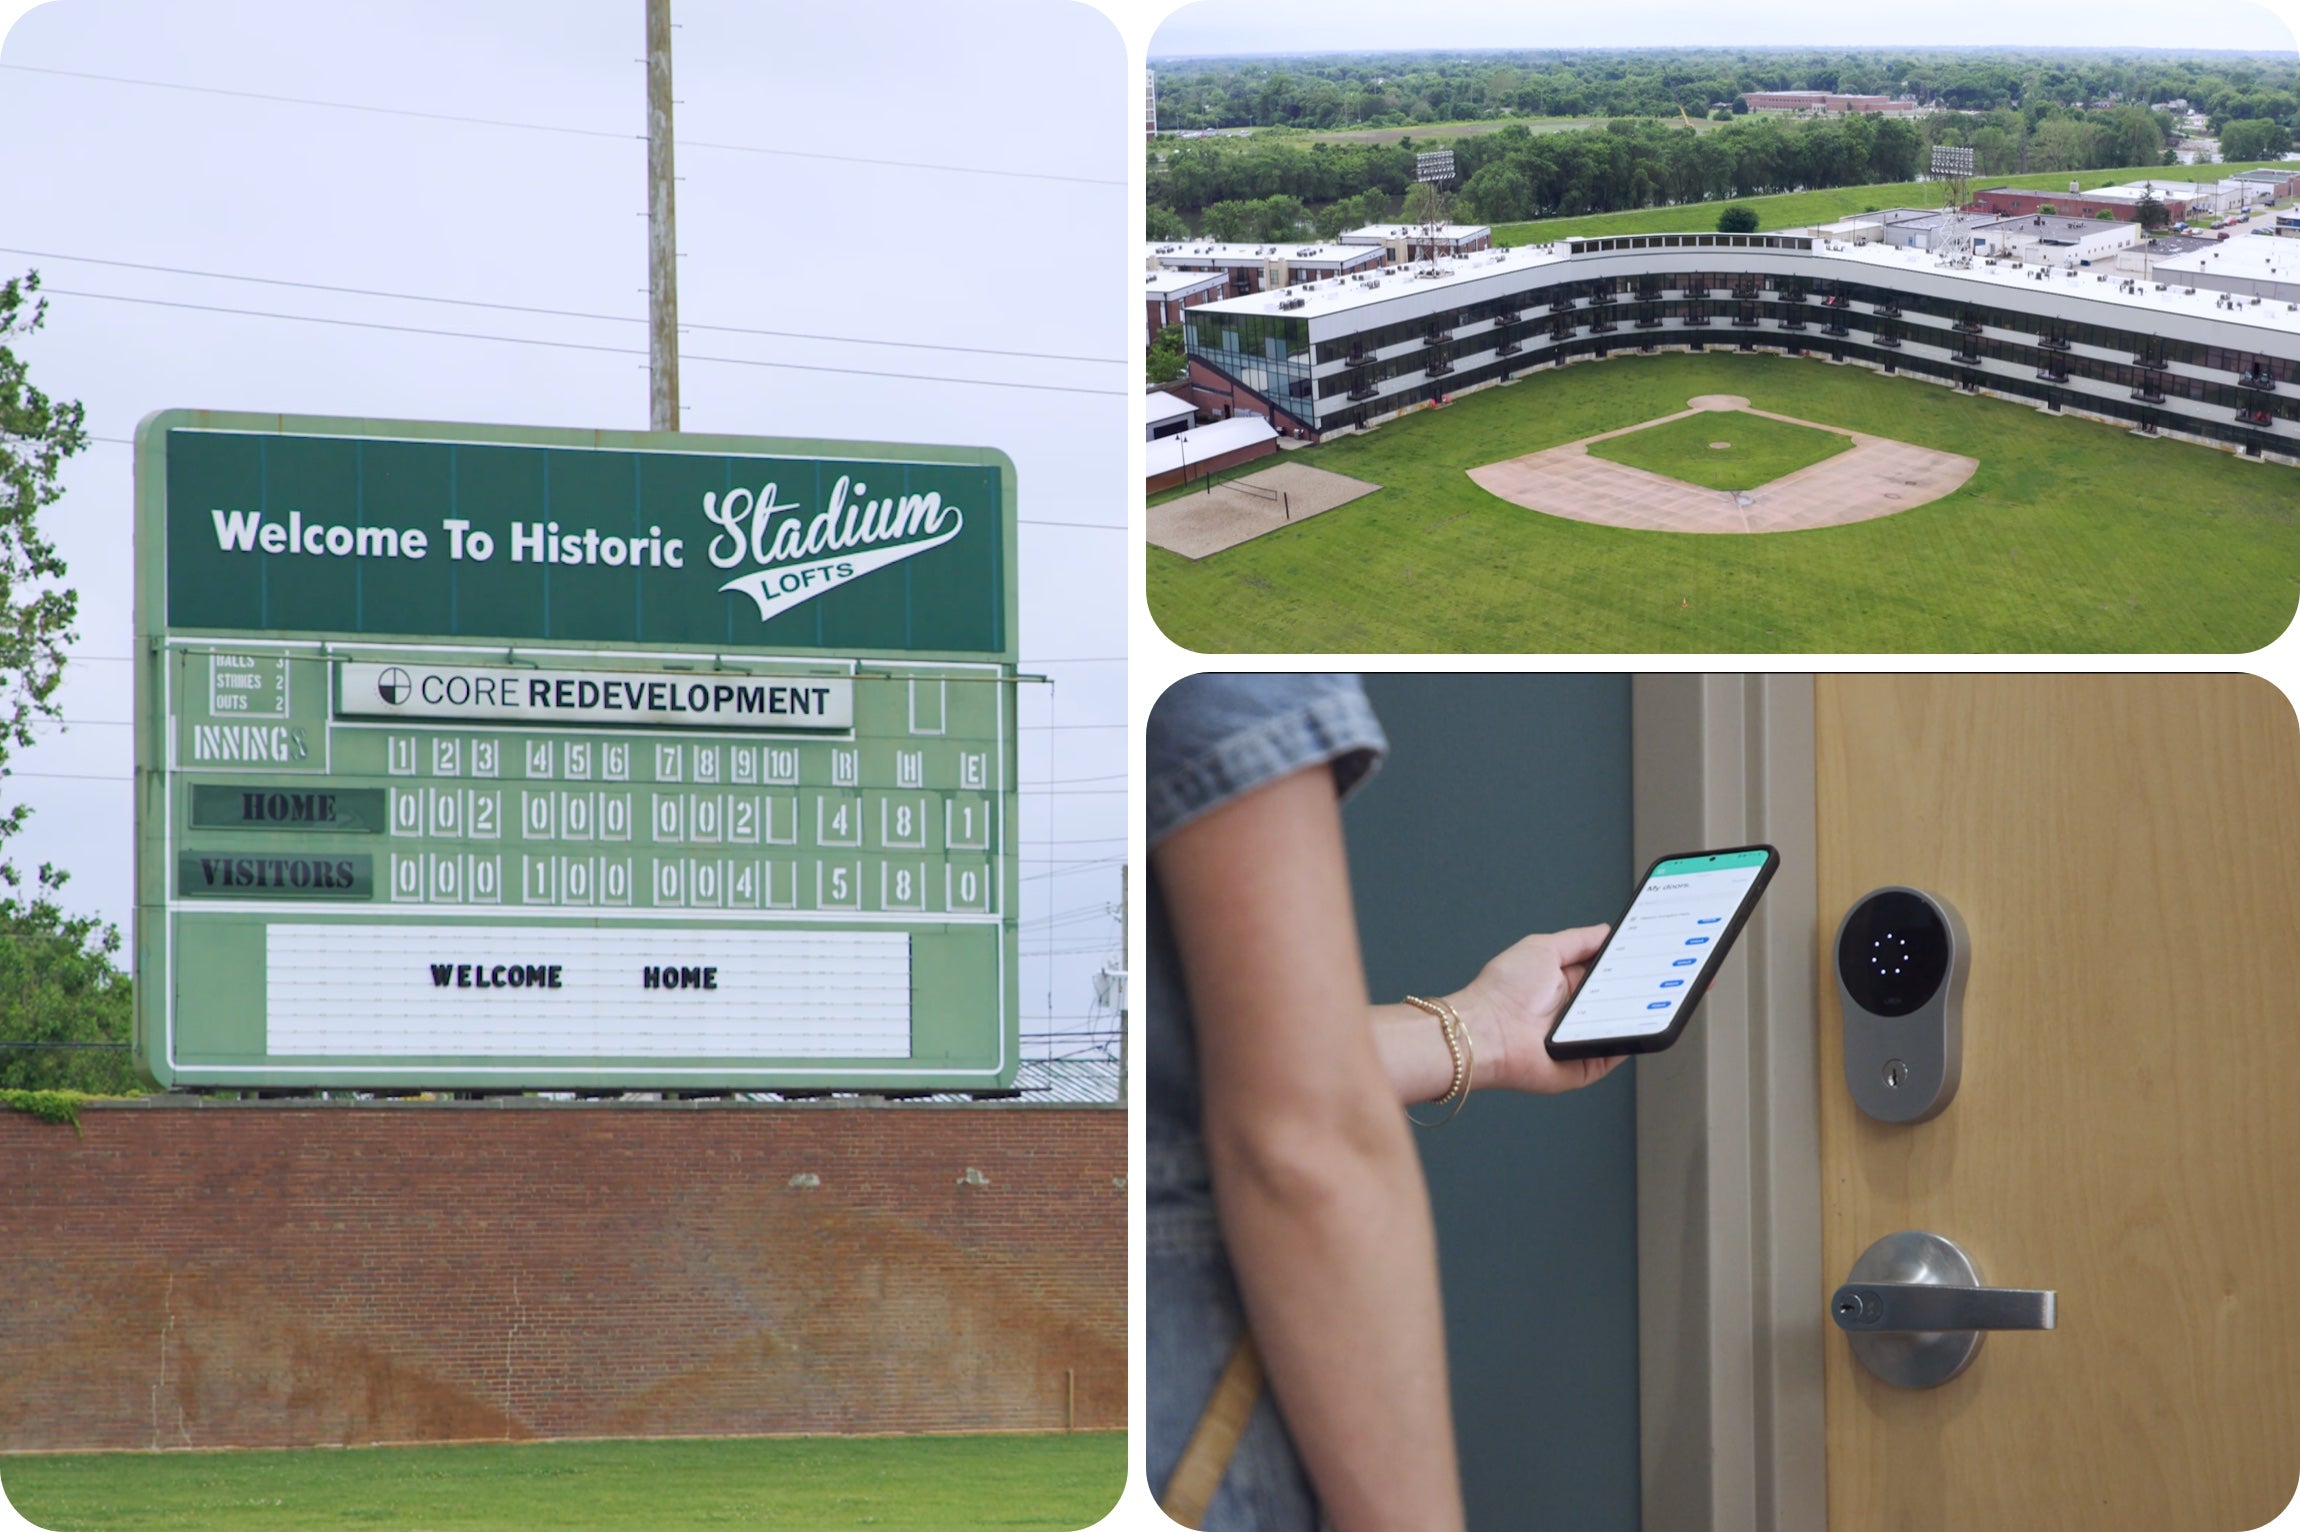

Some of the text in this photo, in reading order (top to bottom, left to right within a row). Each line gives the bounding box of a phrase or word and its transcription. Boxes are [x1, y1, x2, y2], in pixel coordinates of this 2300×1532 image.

[212, 509, 684, 570] Welcome To Historic
[703, 475, 963, 571] Stadium
[760, 561, 855, 601] LOFTS
[216, 673, 284, 690] STRIKES 2
[421, 675, 830, 715] CORE REDEVELOPMENT
[216, 694, 284, 711] OUTS 2
[399, 740, 406, 768] 1
[440, 742, 454, 769] 2
[479, 743, 492, 770] 3
[533, 744, 546, 771] 4
[571, 745, 585, 772] 5
[610, 746, 623, 773] 6
[663, 748, 675, 775] 7
[700, 750, 714, 776] 8
[738, 750, 750, 776] 9
[771, 751, 792, 778] 10
[839, 752, 852, 779] R
[904, 754, 916, 781] H
[968, 755, 979, 782] E
[242, 793, 972, 838] HOME 0 0 2 0 0 0 0 0 2 4 8 1
[200, 858, 976, 902] VISITORS 0 0 0 1 0 0 0 0 4 5 8 0
[1646, 884, 1660, 893] My
[431, 964, 717, 989] WELCOME HOME
